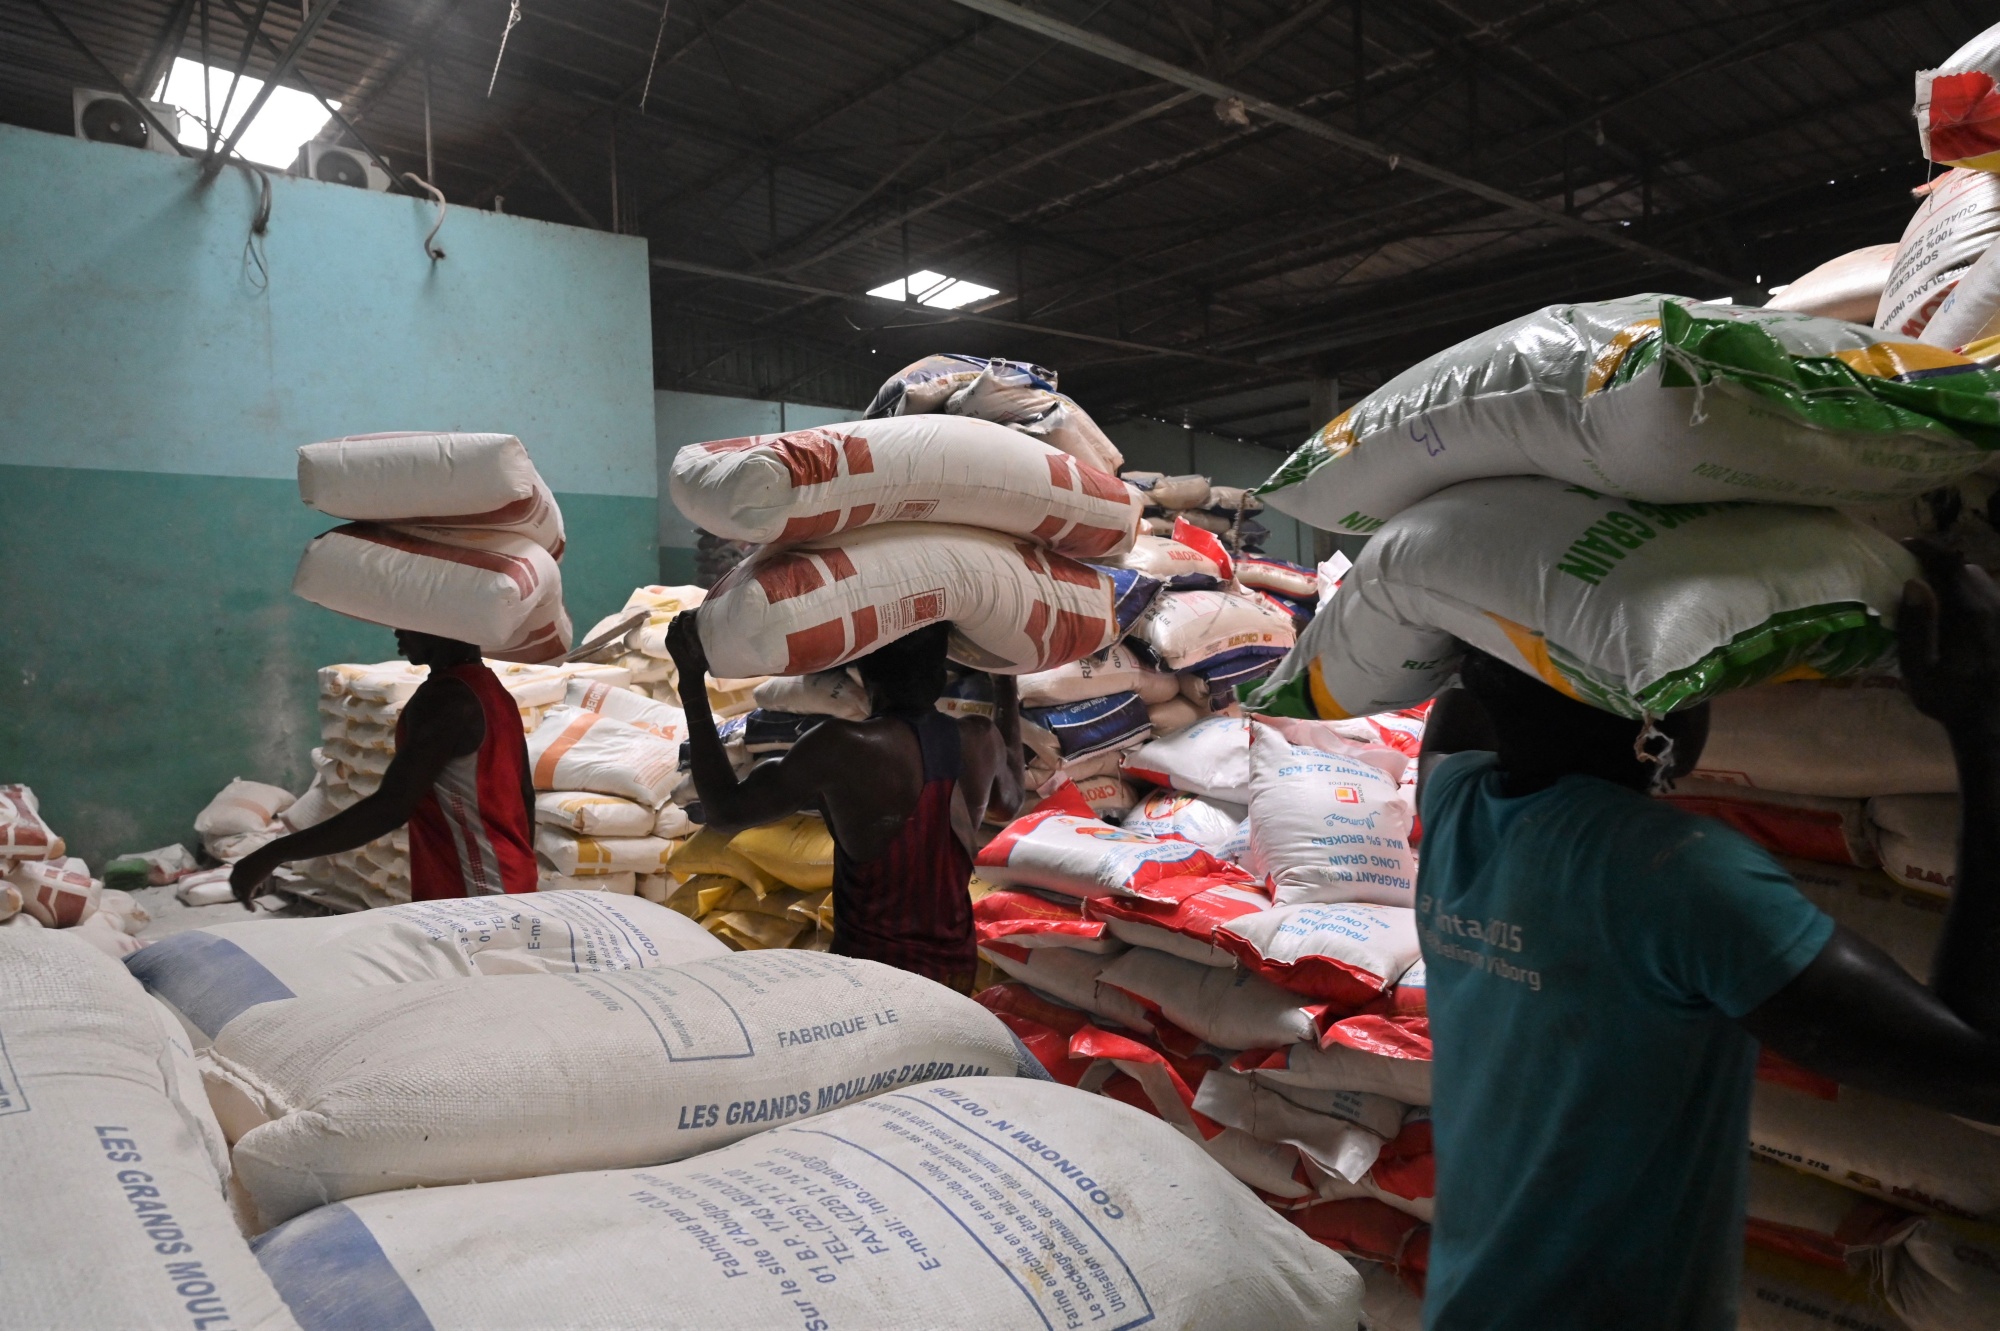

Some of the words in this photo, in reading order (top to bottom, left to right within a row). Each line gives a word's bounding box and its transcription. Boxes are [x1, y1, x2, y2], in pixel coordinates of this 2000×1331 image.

[1927, 203, 1978, 239] QUALITE
[1926, 228, 1954, 252] 100%
[1888, 249, 1939, 298] SORTEXED
[1906, 273, 1946, 303] BLANC
[1166, 550, 1204, 562] CROWN
[1556, 511, 1658, 586] GRAIN
[1227, 633, 1259, 648] CROWN
[1401, 659, 1440, 670] RIZ
[586, 682, 610, 713] BEIGNE
[1278, 766, 1302, 777] KGS
[1305, 764, 1331, 773] 22.5
[1335, 765, 1381, 782] WEIGHT
[1084, 785, 1117, 802] CRO
[1323, 810, 1381, 830] Maman
[1311, 834, 1365, 847] BROKENS
[1365, 835, 1382, 846] 5%
[1383, 837, 1404, 850] MAX.
[1134, 846, 1158, 860] POIDS
[1328, 854, 1368, 866] GRAIN
[1370, 855, 1401, 870] LONG
[1331, 869, 1353, 882] RIC
[1355, 870, 1411, 890] FRAGRANT
[1334, 913, 1370, 931] LONG
[777, 1016, 868, 1048] FABRIQUE
[874, 1009, 899, 1027] LE
[677, 1104, 719, 1130] LES
[725, 1090, 811, 1126] GRANDS
[815, 1065, 897, 1111] MOULINS
[928, 1087, 989, 1117] 007/06
[984, 1119, 1015, 1132] N°
[94, 1125, 143, 1162] LES
[952, 1142, 967, 1151] de
[938, 1153, 972, 1174] endroit
[962, 1149, 1003, 1176] maximum
[1807, 1158, 1830, 1172] RIZ
[967, 1170, 984, 1183] un
[999, 1171, 1023, 1191] délai
[1009, 1130, 1125, 1220] CODINORM
[698, 1177, 763, 1208] ABIDJAN
[751, 1183, 780, 1194] 21
[799, 1184, 827, 1196] 21
[946, 1180, 974, 1201] acide
[978, 1181, 1004, 1201] dans
[1016, 1187, 1034, 1200] un
[768, 1193, 797, 1205] 21
[968, 1199, 986, 1212] en
[998, 1200, 1019, 1216] fait
[1028, 1198, 1054, 1218] dans
[116, 1170, 194, 1255] GRANDS
[663, 1208, 698, 1223] par
[750, 1207, 790, 1233] 1743
[978, 1210, 995, 1221] et
[990, 1218, 1007, 1236] fer
[1015, 1213, 1038, 1233] être
[883, 1216, 942, 1271] E-mail:
[1003, 1229, 1021, 1246] en
[1029, 1231, 1056, 1251] doit
[1048, 1217, 1089, 1256] optimale
[679, 1223, 749, 1279] Fabriqué
[783, 1234, 819, 1261] B.P.
[753, 1249, 787, 1276] site
[1016, 1246, 1057, 1288] enrichie
[807, 1265, 837, 1284] 01
[1051, 1250, 1095, 1302] stockage
[1083, 1256, 1127, 1313] Utilisation
[164, 1261, 236, 1331] MOUL
[780, 1279, 802, 1295] le
[793, 1300, 829, 1331] Sur
[1052, 1288, 1083, 1330] Farine
[1088, 1303, 1106, 1321] Le
